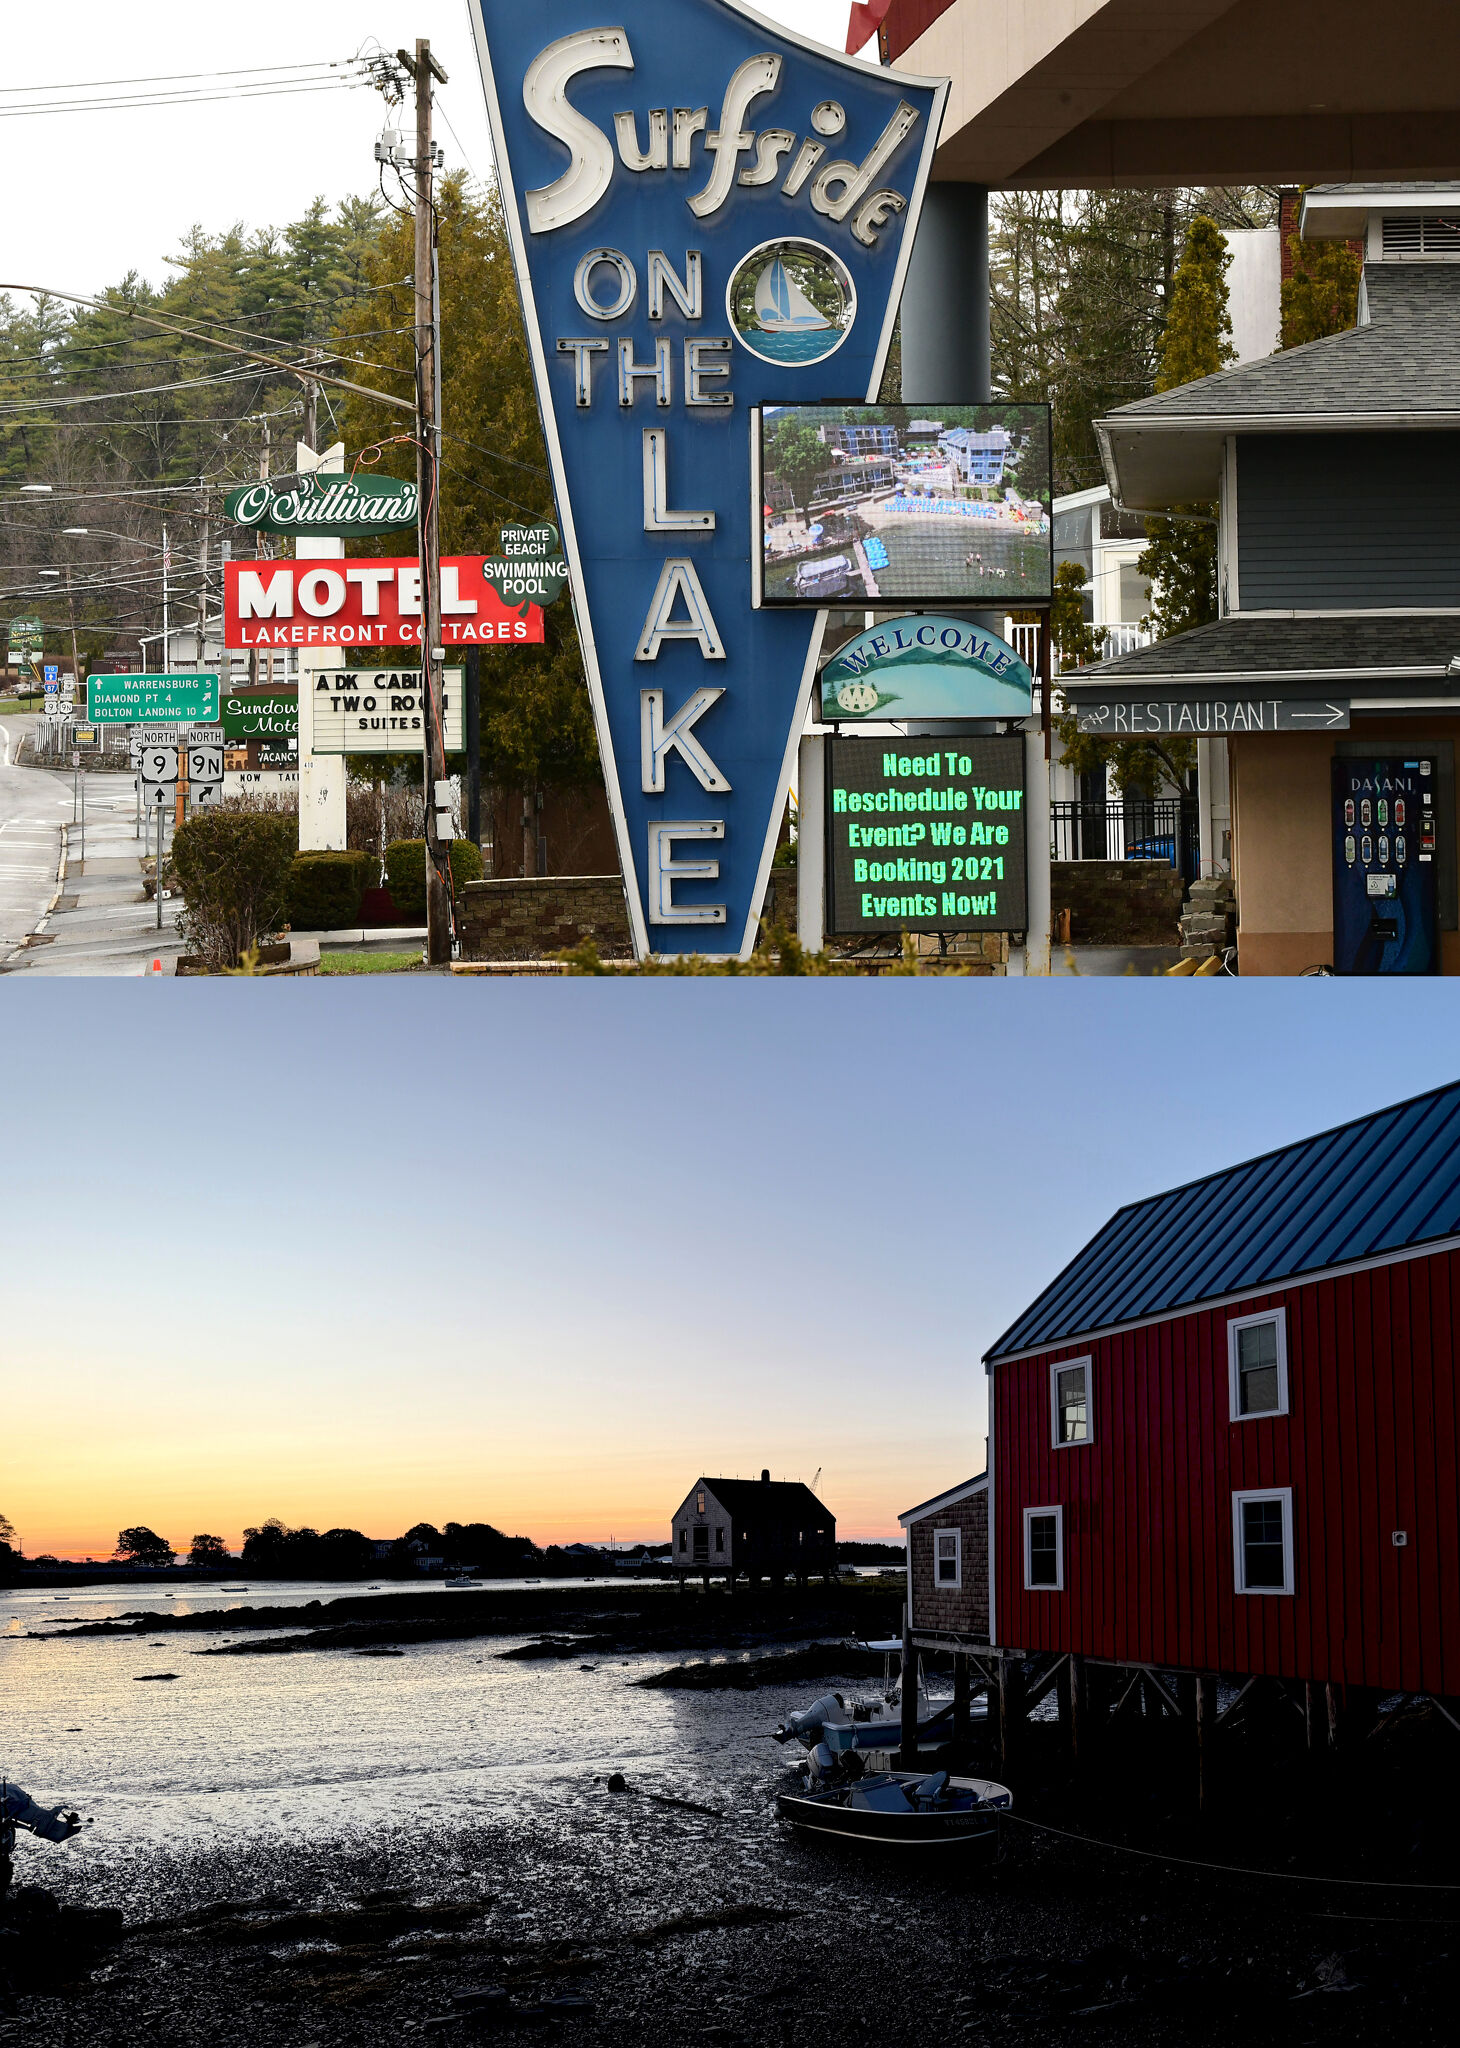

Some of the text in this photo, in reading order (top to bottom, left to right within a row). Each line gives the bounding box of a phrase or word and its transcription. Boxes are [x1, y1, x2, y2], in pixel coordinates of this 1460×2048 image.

[522, 25, 920, 247] Surfside
[573, 247, 703, 321] ON
[556, 336, 734, 408] THE
[235, 477, 418, 526] O'Sullivan's
[501, 529, 550, 542] PRIVATE
[505, 543, 546, 555] BEACH
[483, 561, 568, 579] SWIMMING
[238, 566, 478, 619] MOTEL
[503, 578, 548, 595] POOL
[241, 621, 528, 644] LAKEFRONT CTAGES
[841, 624, 1012, 677] WELCOME
[124, 680, 212, 690] WARRENSBURG 5
[316, 673, 446, 691] ADK CABI
[632, 426, 733, 926] LAKE
[48, 703, 54, 711] 9
[61, 703, 71, 711] 9N
[95, 694, 172, 703] DIAMOND PT 4
[226, 699, 298, 715] Sundow
[330, 695, 448, 712] TWO RO
[95, 707, 197, 717] BOLTON LANDING 10
[1114, 700, 1283, 733] RESTAURANT
[243, 717, 298, 733] Mote
[359, 717, 421, 730] SUITES
[144, 732, 176, 743] NORTH
[190, 731, 221, 742] NORTH
[153, 755, 166, 775] 9
[192, 755, 220, 775] 9N
[258, 752, 298, 763] VACANCY
[883, 752, 973, 777] Need To
[240, 773, 261, 782] NOW
[1351, 775, 1412, 795] DASANI
[833, 786, 1022, 813] Reschedule Your
[848, 821, 1009, 848] Event? We Are
[854, 856, 1004, 884] Booking 2021
[861, 891, 997, 918] Events Now!
